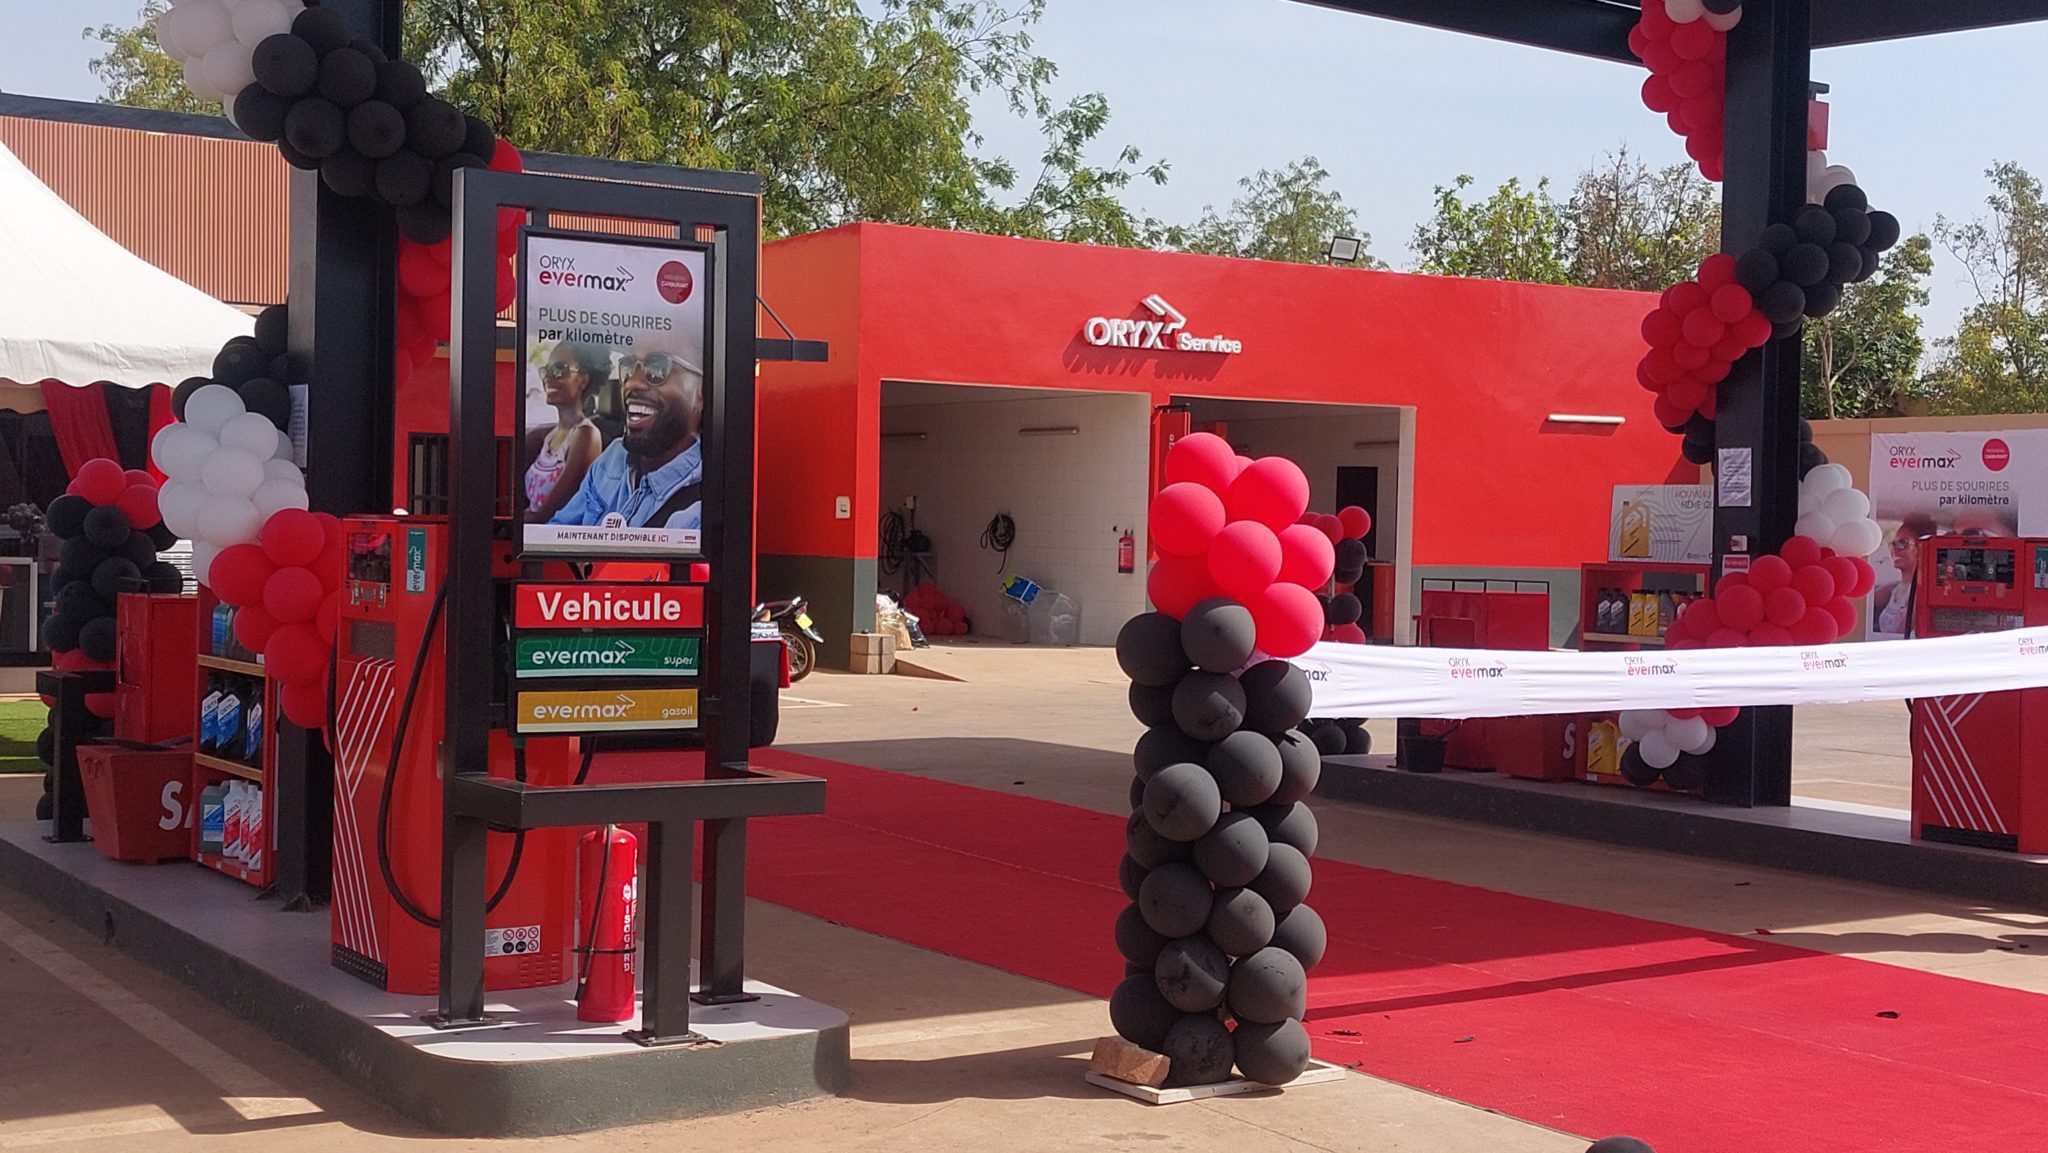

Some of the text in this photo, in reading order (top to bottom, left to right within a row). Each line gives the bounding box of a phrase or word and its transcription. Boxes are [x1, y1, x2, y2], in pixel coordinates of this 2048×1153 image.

[540, 255, 575, 271] ORYX
[539, 270, 626, 292] evermax
[539, 308, 672, 331] PLUS DE SOURIRES
[538, 327, 634, 346] par kilomètre
[1084, 317, 1242, 354] ORYX Service
[1889, 446, 1916, 456] ORYX
[1890, 456, 1955, 468] evermax
[1912, 480, 2010, 492] PLUS DE SOURIRES
[1939, 494, 2010, 507] par kilomètre
[557, 531, 609, 541] MAINTENANT
[610, 533, 656, 543] DISPONIBLE
[658, 534, 669, 543] ICI
[413, 549, 422, 591] evermax
[537, 592, 681, 621] Vehicule
[532, 650, 693, 667] evermax super
[1451, 667, 1503, 679] evermax
[1628, 665, 1676, 676] evermax
[533, 704, 693, 718] evermax gasoil
